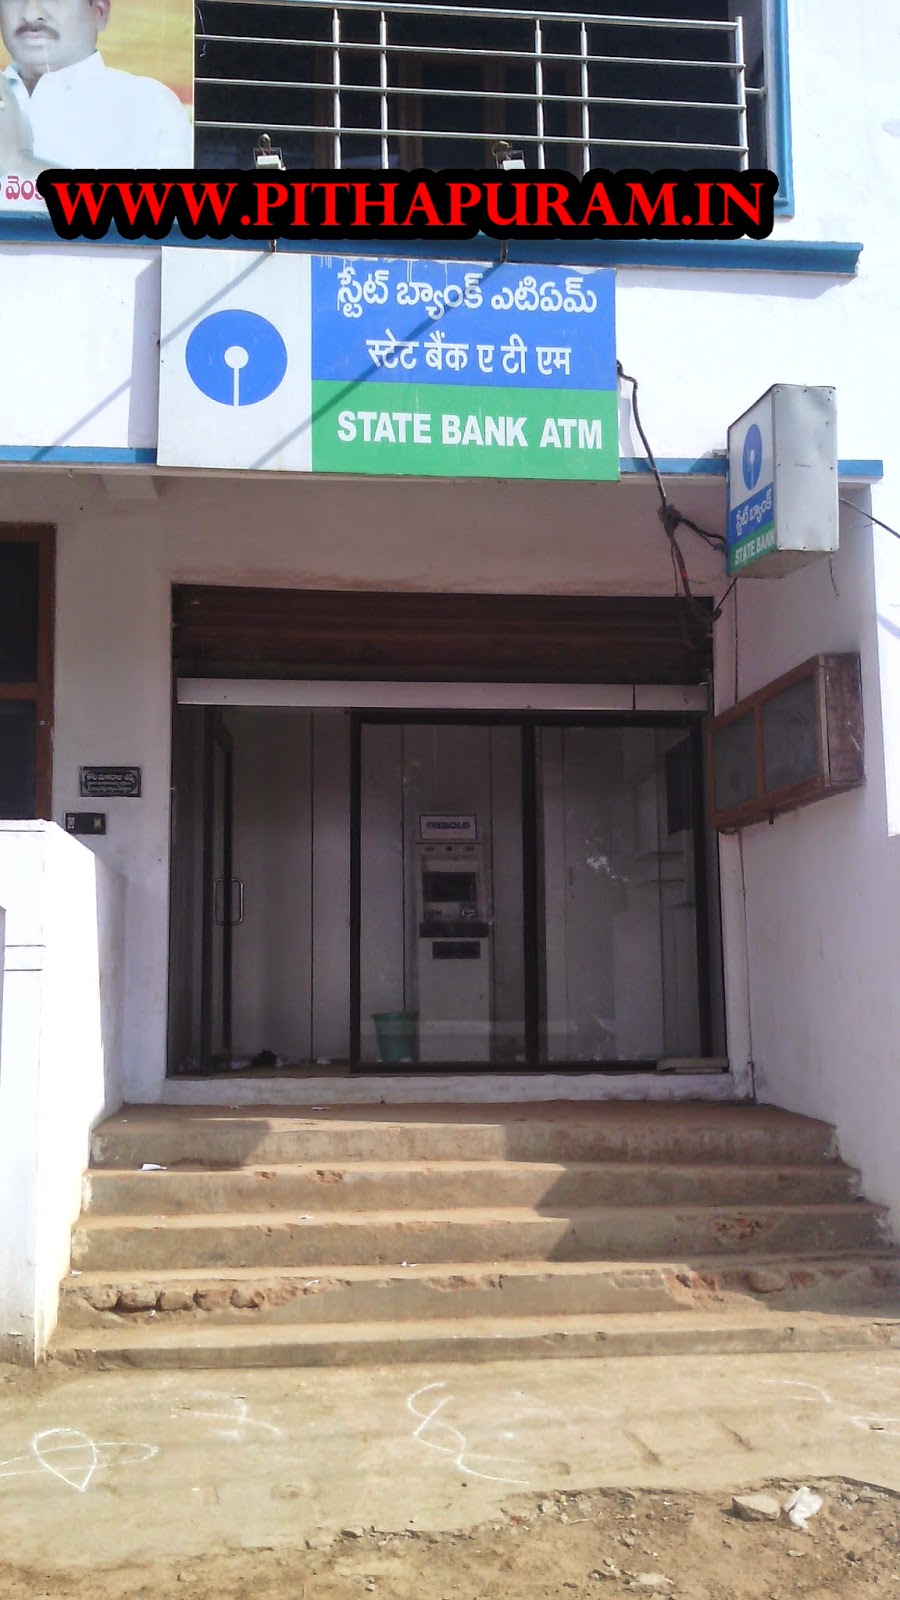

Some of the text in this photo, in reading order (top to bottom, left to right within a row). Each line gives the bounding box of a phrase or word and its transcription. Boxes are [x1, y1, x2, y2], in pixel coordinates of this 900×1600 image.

[337, 267, 389, 318] స్టేట్
[396, 273, 483, 320] బ్యాంక్
[366, 328, 571, 375] स्टेट बैंक ए टी एम
[337, 411, 602, 450] STATE BANK ATM
[735, 527, 775, 566] STATE BANK
